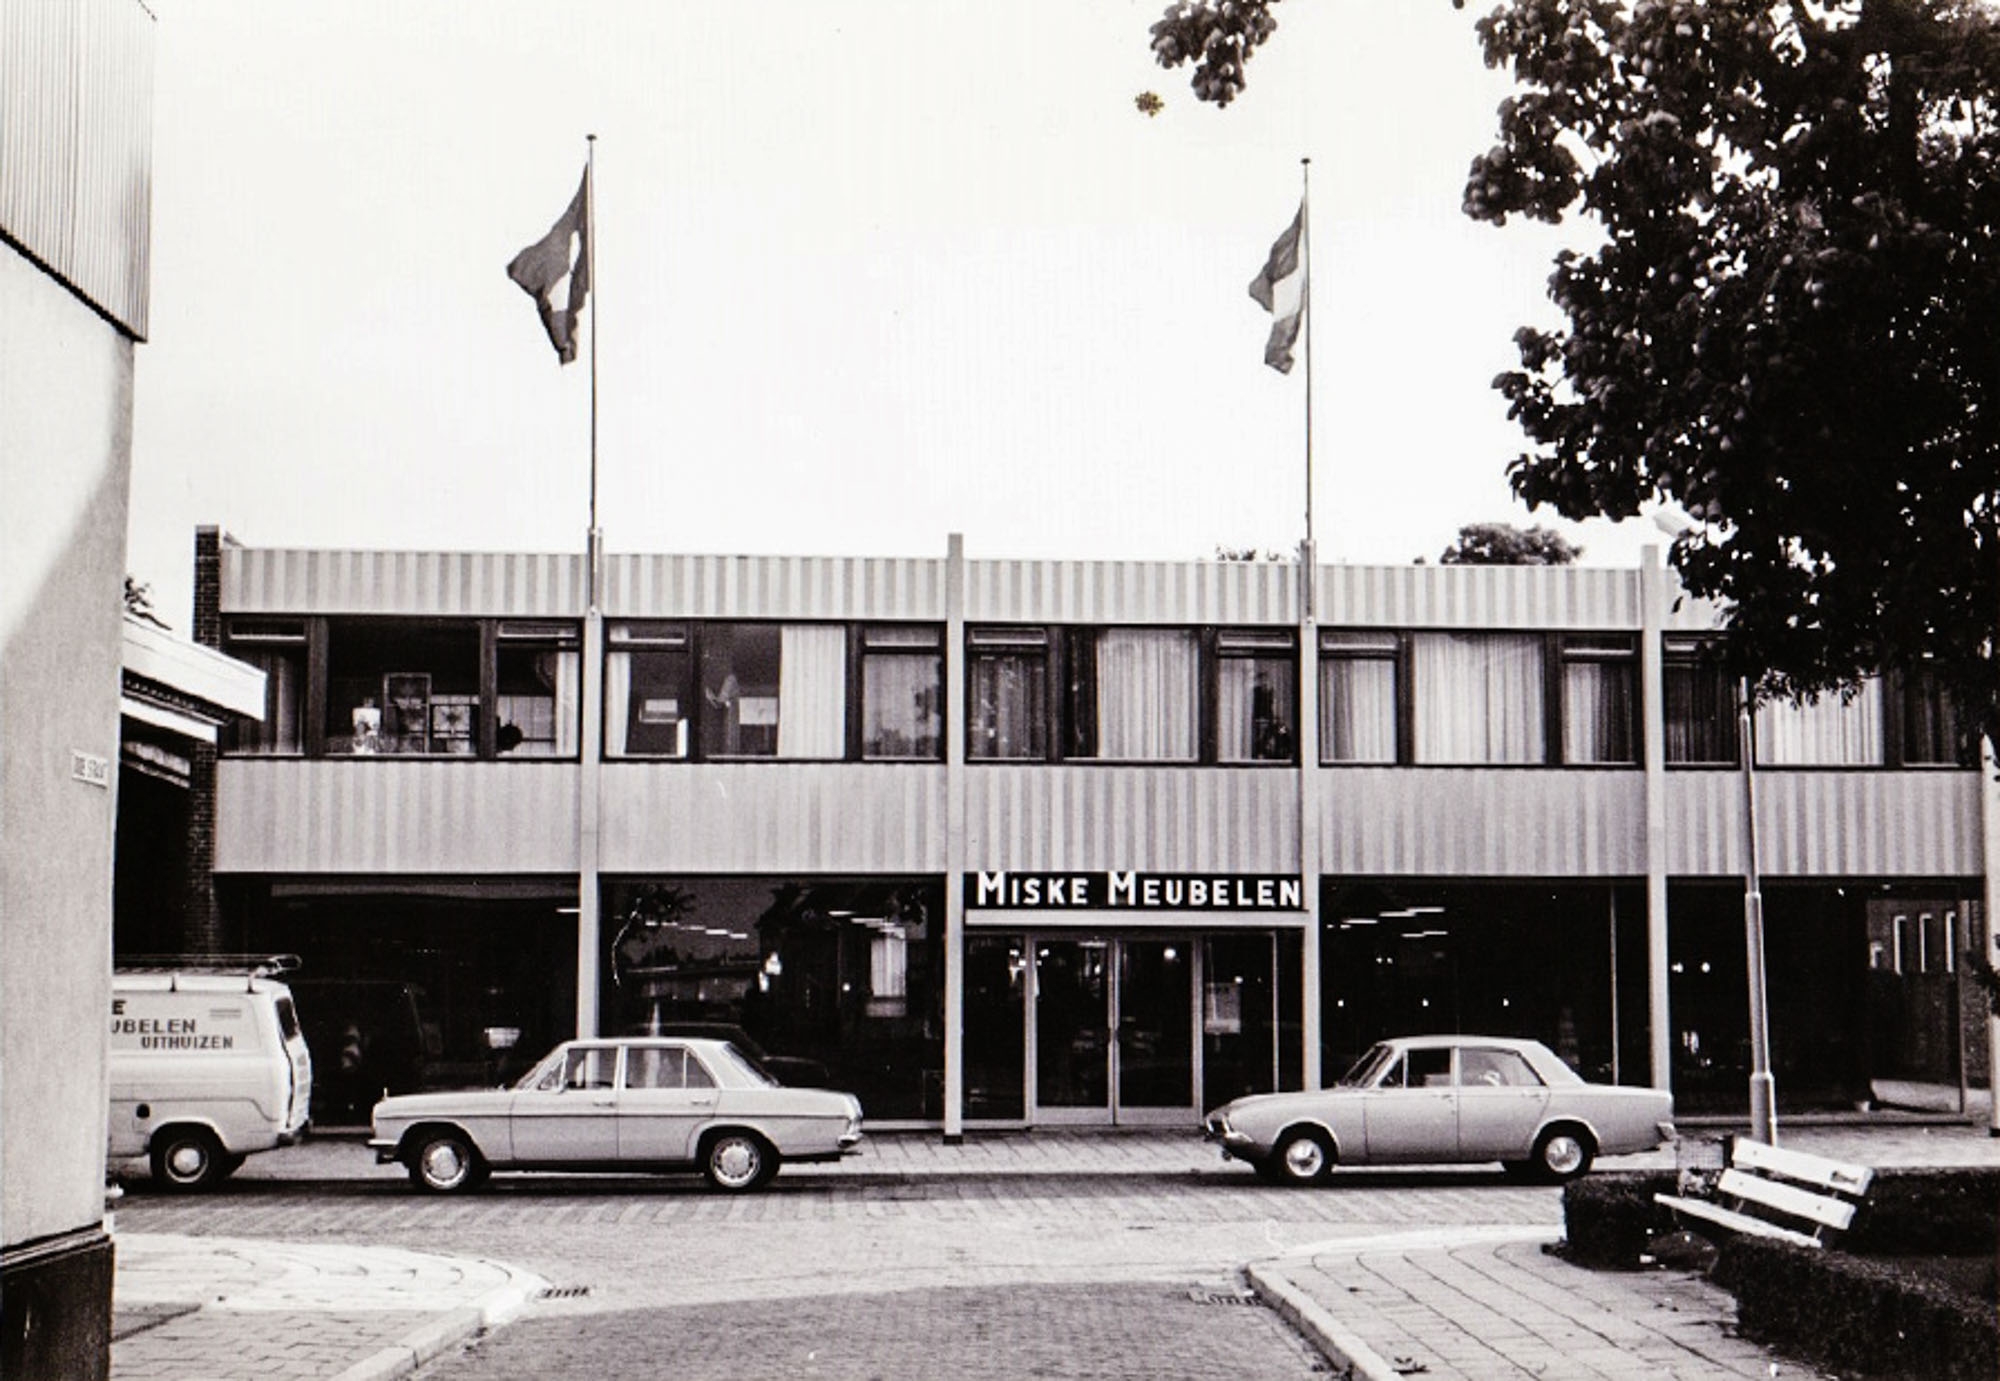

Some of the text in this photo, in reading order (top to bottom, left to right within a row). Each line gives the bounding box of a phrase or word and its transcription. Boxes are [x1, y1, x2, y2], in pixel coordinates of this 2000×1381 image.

[977, 870, 1301, 907] MISKE MEUBELEN
[141, 1035, 234, 1049] UITHUIZEN
